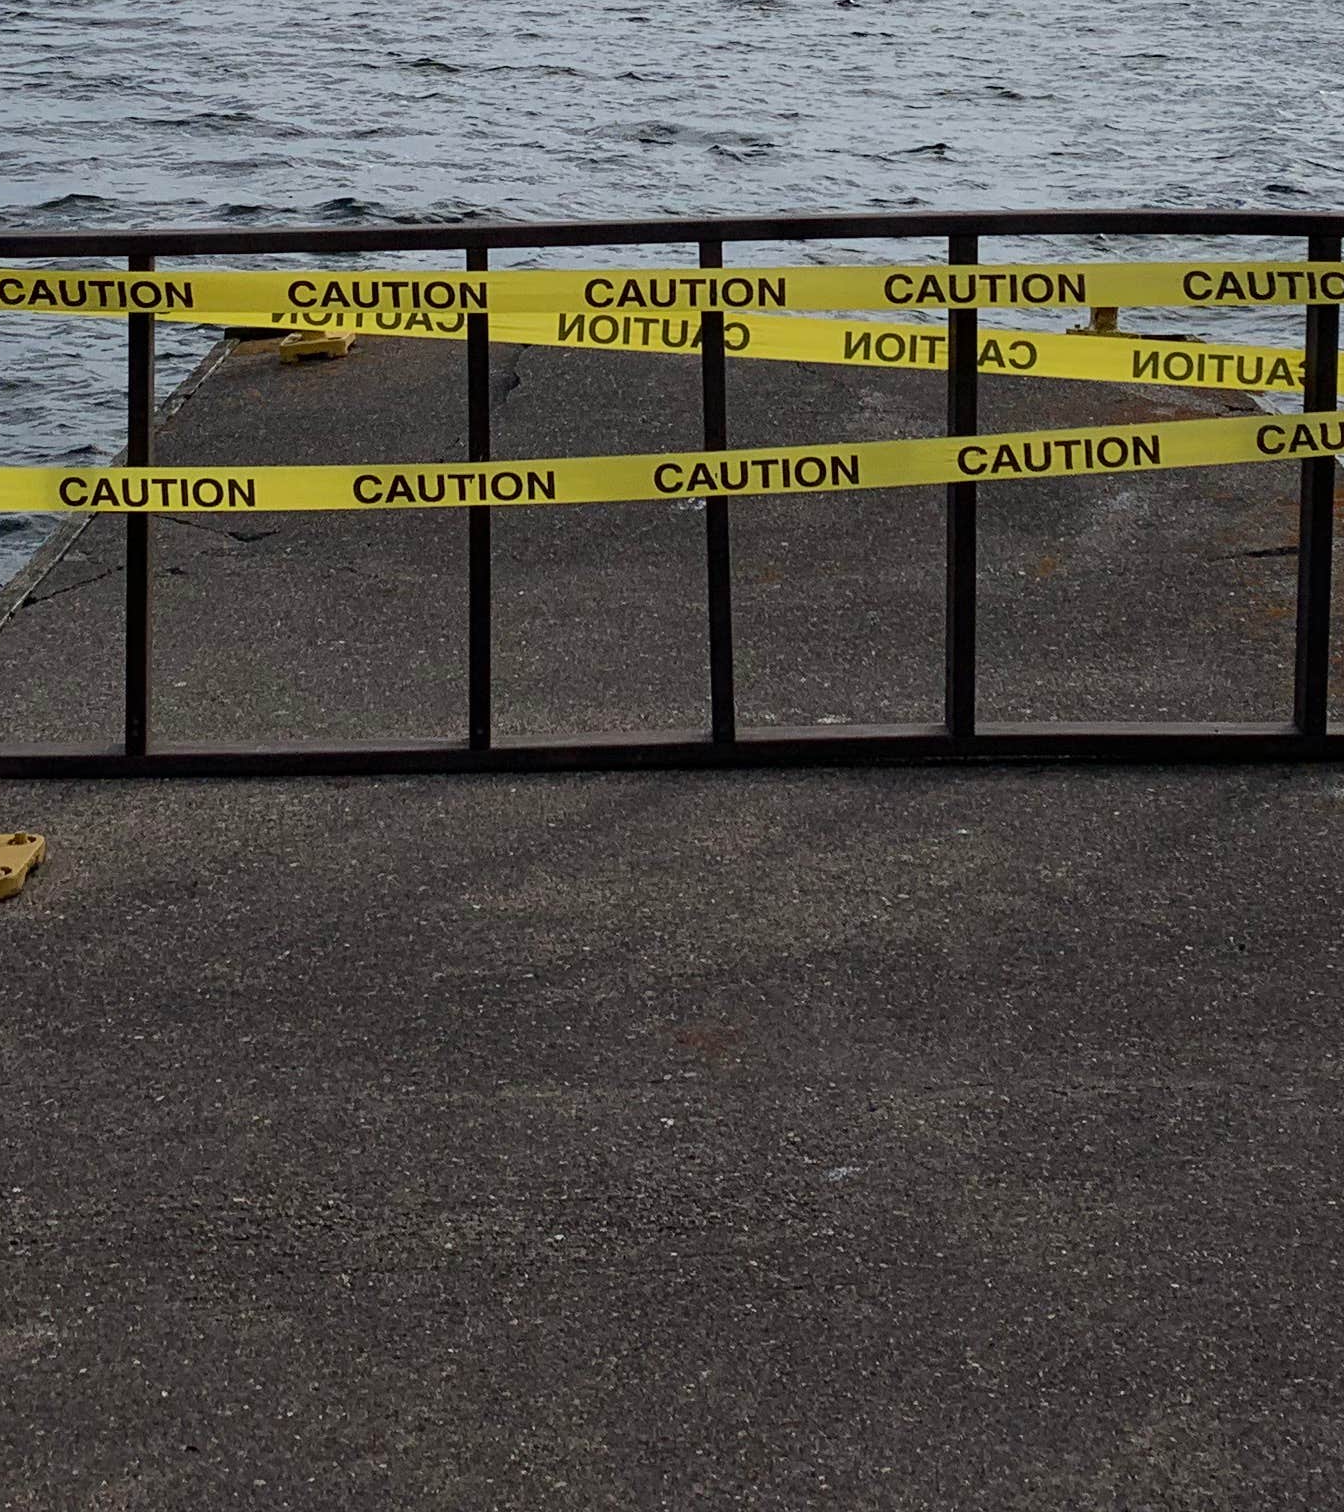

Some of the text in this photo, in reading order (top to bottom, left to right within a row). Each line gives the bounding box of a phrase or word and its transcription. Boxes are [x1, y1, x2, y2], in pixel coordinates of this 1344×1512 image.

[288, 280, 487, 309] CAUTION
[584, 278, 786, 307] CAUTION
[884, 273, 1086, 304] CAUTION
[59, 477, 255, 507] CAUTION
[353, 471, 556, 504] CAUTION
[654, 455, 859, 493] CAUTION
[957, 435, 1160, 475] CAUTION
